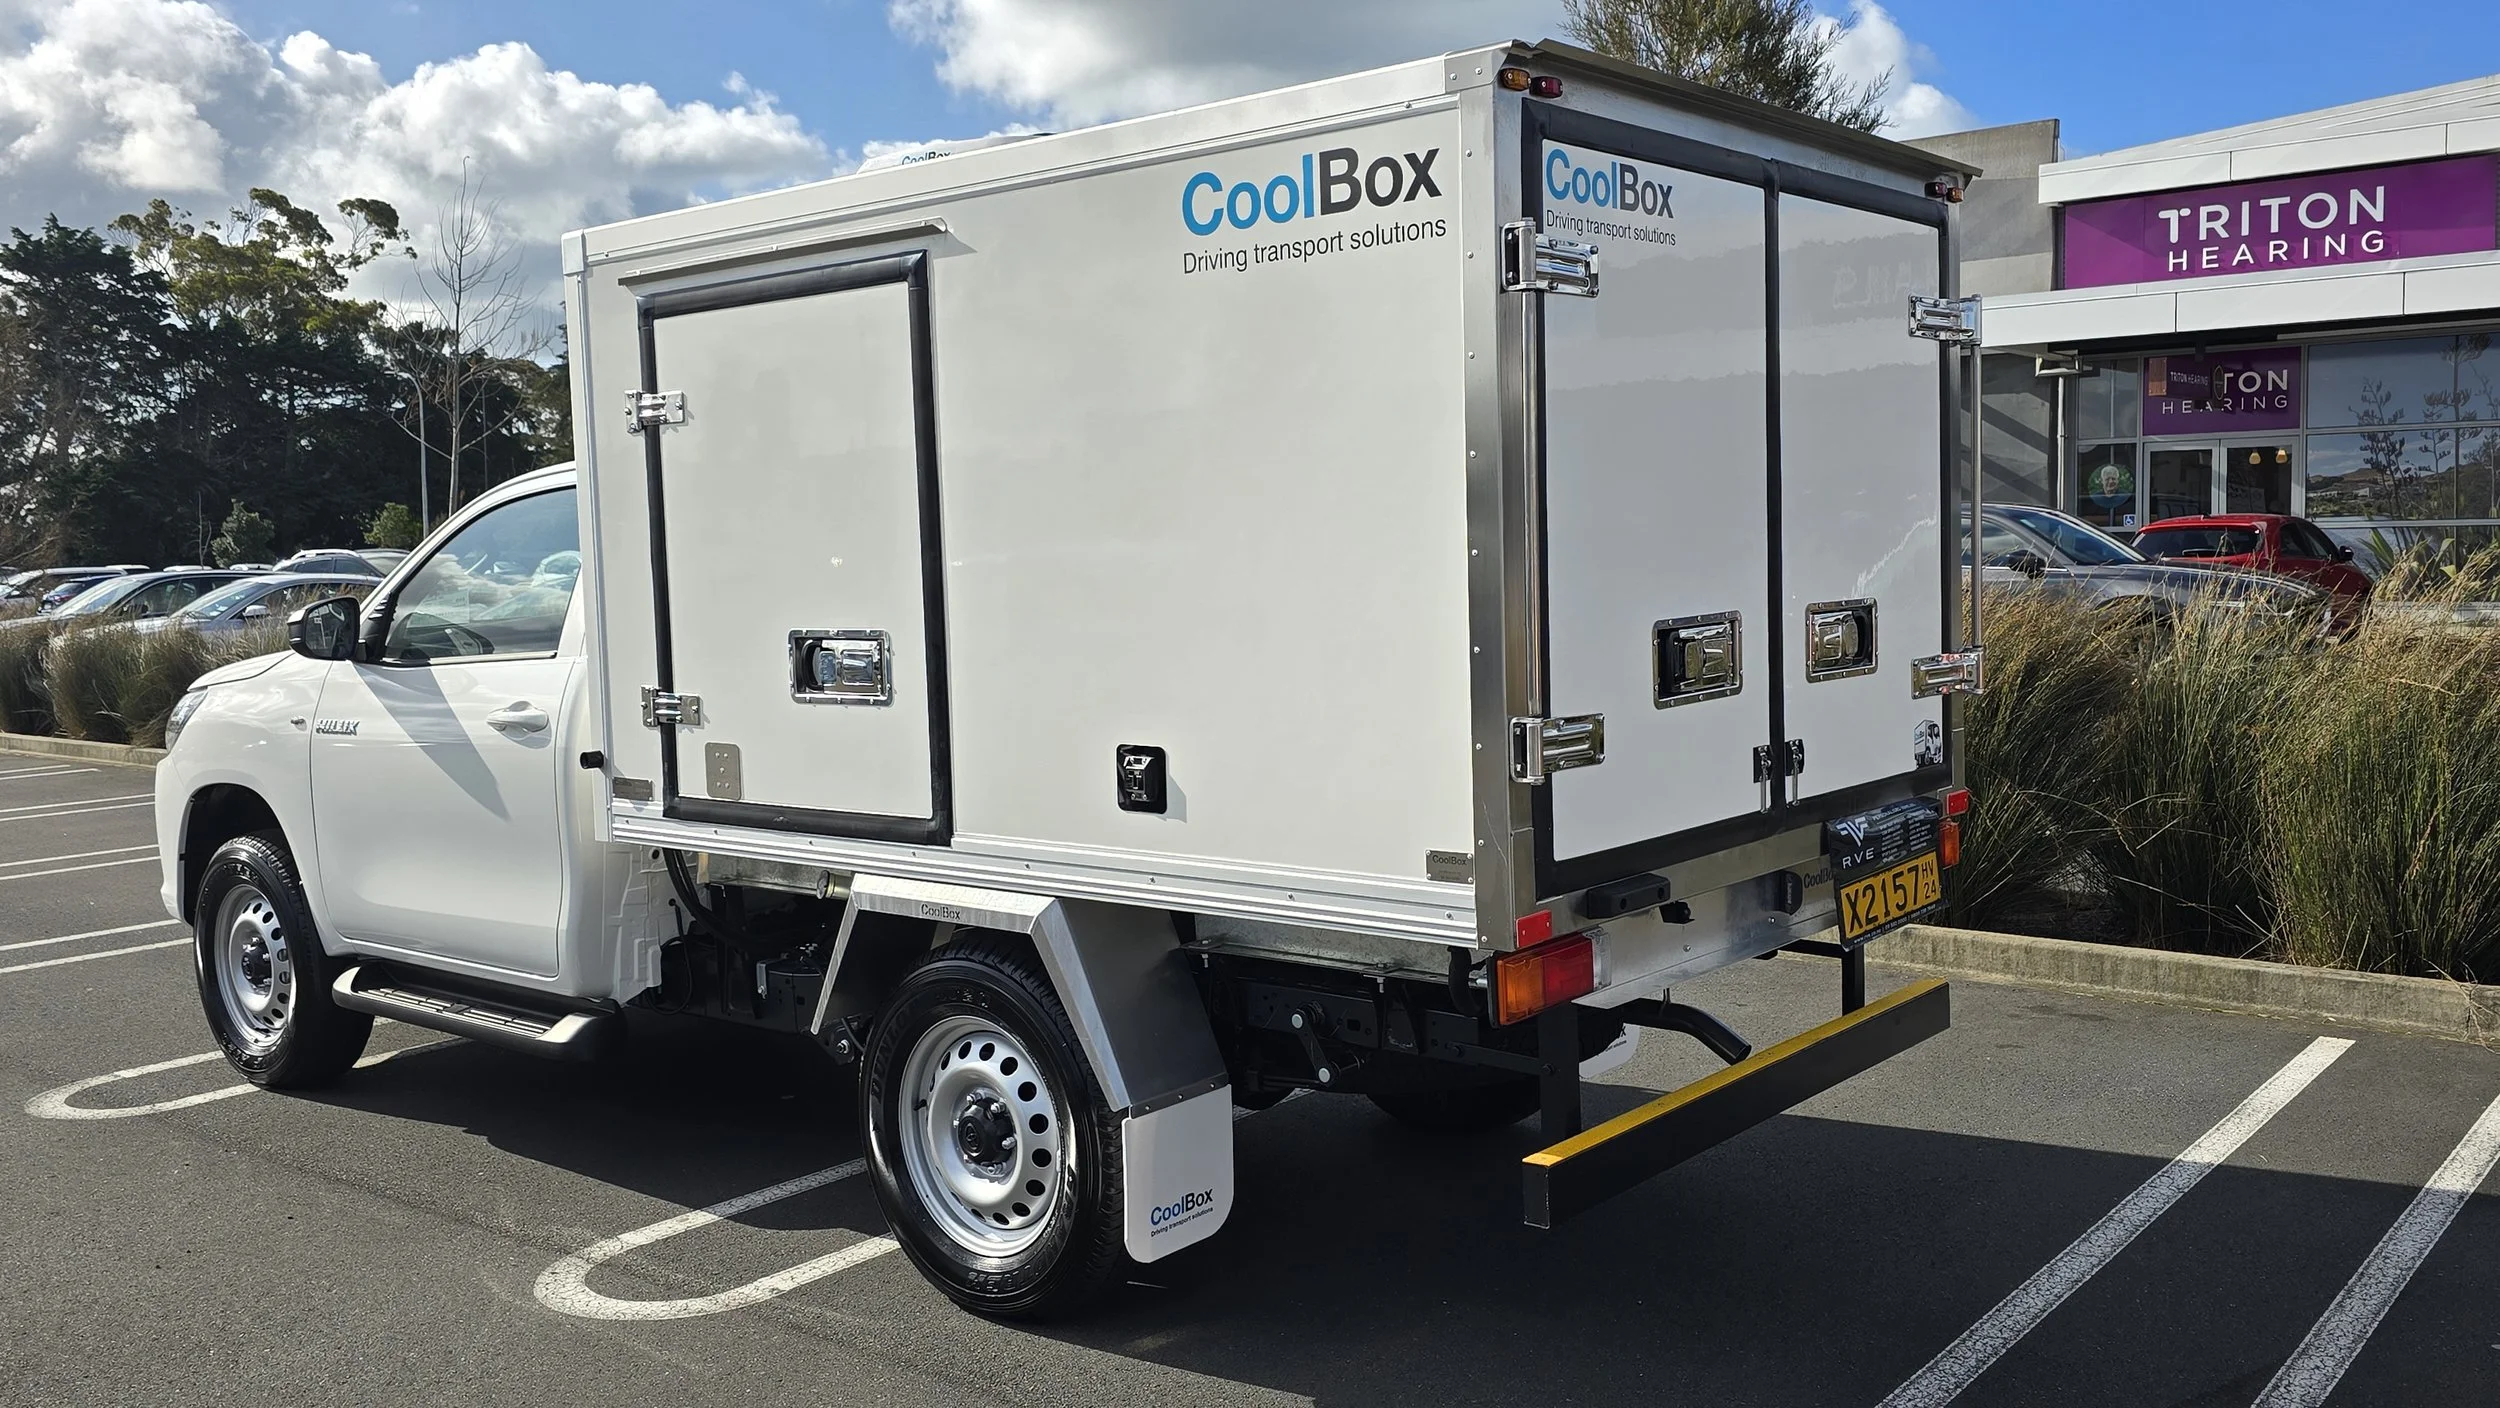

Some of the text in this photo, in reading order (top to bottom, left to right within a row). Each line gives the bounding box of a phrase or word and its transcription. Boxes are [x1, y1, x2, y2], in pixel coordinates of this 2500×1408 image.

[1182, 147, 1442, 237] CoolBox
[1546, 149, 1674, 219] CoolBox
[1547, 210, 1677, 246] Driving transport solutions
[2158, 185, 2385, 244] TRITON
[1183, 219, 1447, 274] Driving transport solutions
[2168, 231, 2384, 272] HEARING
[2223, 369, 2288, 394] TON
[1432, 855, 1467, 866] CoolBox
[1842, 847, 1875, 869] RVE
[1804, 868, 1834, 889] CoolBo
[1923, 879, 1937, 900] 24
[921, 903, 961, 920] CoolBox
[1845, 864, 1920, 934] X2157
[1150, 1188, 1213, 1226] CoolBox
[1150, 1207, 1214, 1237] Driving transport solutions
